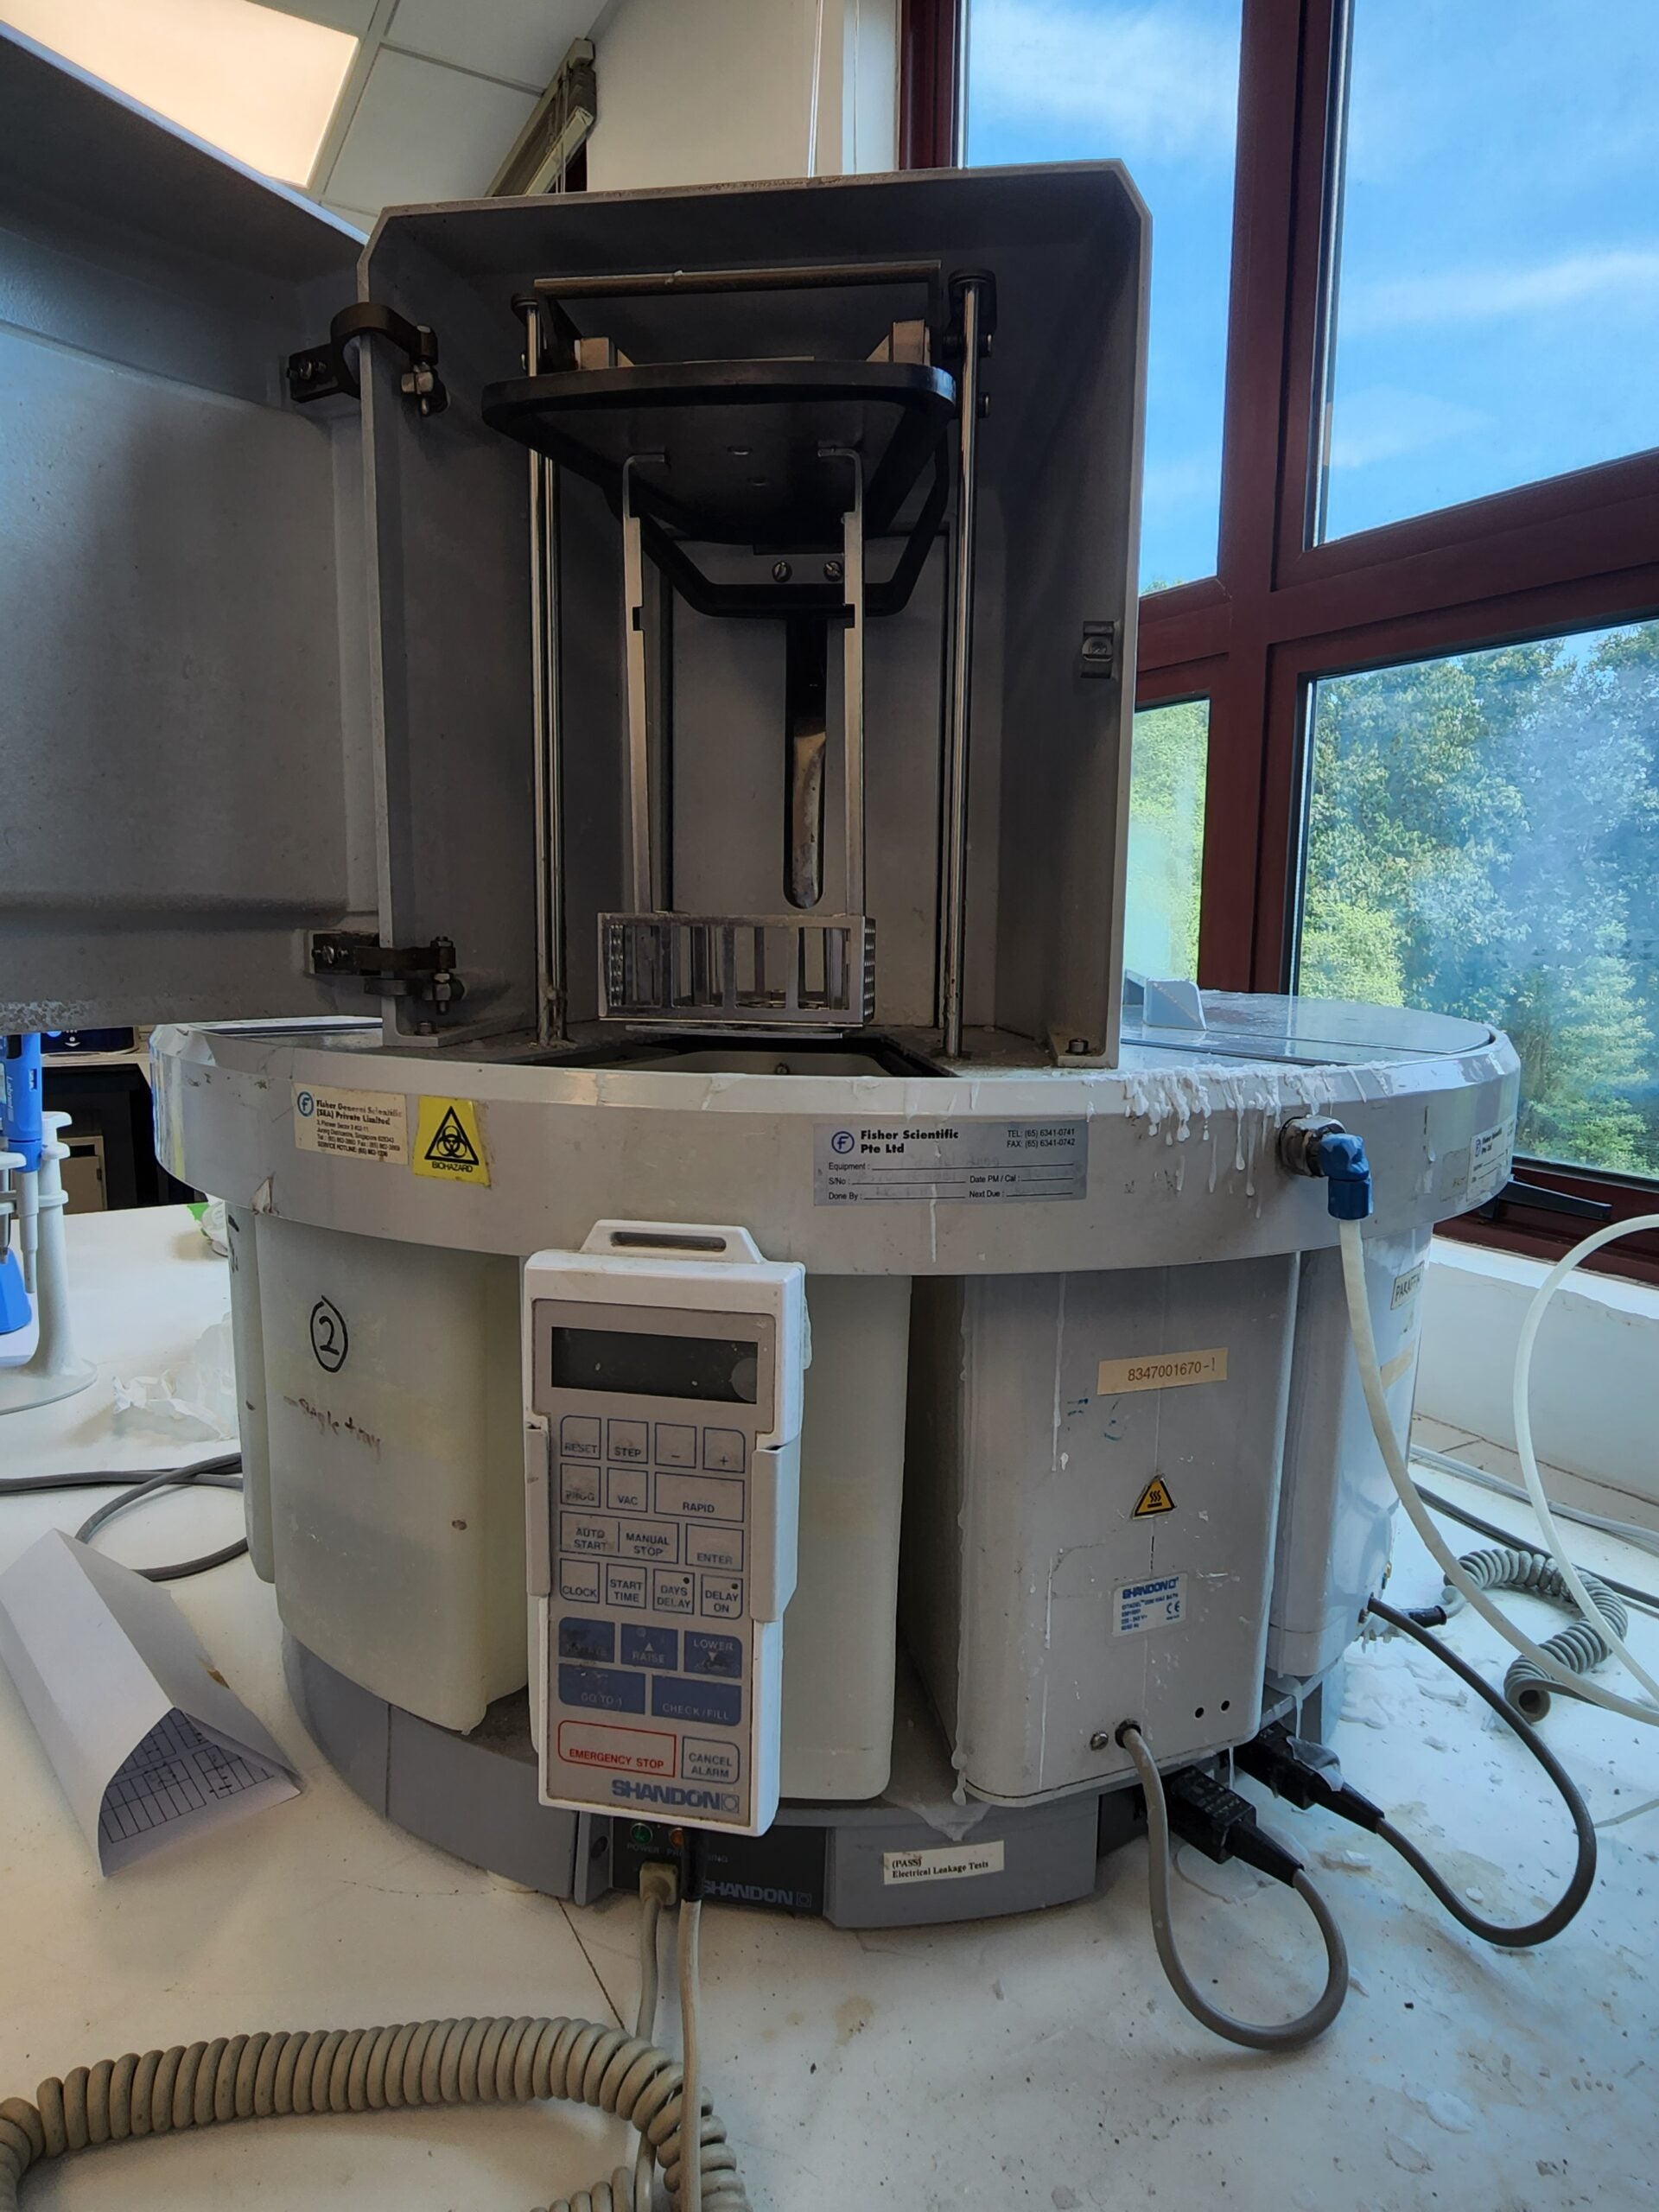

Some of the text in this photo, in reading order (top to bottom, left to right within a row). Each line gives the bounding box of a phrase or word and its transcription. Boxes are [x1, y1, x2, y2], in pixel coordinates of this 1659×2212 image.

[316, 1100, 336, 1110] Fisher
[335, 1111, 360, 1122] Private
[363, 1115, 391, 1125] Limited
[861, 1128, 959, 1140] Fisher Scientific
[1025, 1128, 1039, 1138] (65)
[1039, 1128, 1075, 1137] 6341-0741
[861, 1143, 905, 1154] Pte Ltd
[1025, 1139, 1039, 1148] (65)
[1039, 1138, 1075, 1147] 6341-0742
[432, 1161, 474, 1173] BIOHAZARD
[969, 1175, 986, 1184] Date
[988, 1174, 1000, 1183] PM
[829, 1192, 858, 1202] Done By
[969, 1190, 985, 1198] Next
[319, 1315, 340, 1356] 2
[564, 1442, 598, 1454] RESET
[614, 1446, 641, 1458] STEP
[617, 1495, 639, 1506] VAC
[683, 1502, 715, 1513] RAPID
[575, 1528, 605, 1539] AUTO
[626, 1532, 670, 1546] MANUAL
[574, 1539, 607, 1550] START
[633, 1545, 664, 1556] STOP
[696, 1553, 733, 1566] ENTER
[610, 1579, 644, 1591] START
[661, 1585, 688, 1596] DAYS
[1122, 1580, 1168, 1599] SHANDON
[563, 1586, 597, 1598] CLOCK
[613, 1591, 639, 1603] TIME
[705, 1590, 739, 1602] DELAY
[657, 1597, 690, 1609] DELAY
[714, 1602, 729, 1613] ON
[694, 1638, 734, 1651] LOWER
[632, 1651, 665, 1664] RAISE
[600, 1694, 614, 1705] TO
[569, 1748, 664, 1769] EMERGENCY STOP
[689, 1752, 733, 1767] CANCEL
[691, 1767, 729, 1778] ALARM
[612, 1779, 721, 1810] SHANDON
[627, 1843, 659, 1854] POWER
[892, 1858, 922, 1870] (PASS)
[893, 1860, 988, 1878] Electrical Leakage Tests
[702, 1879, 793, 1906] SHANDON
